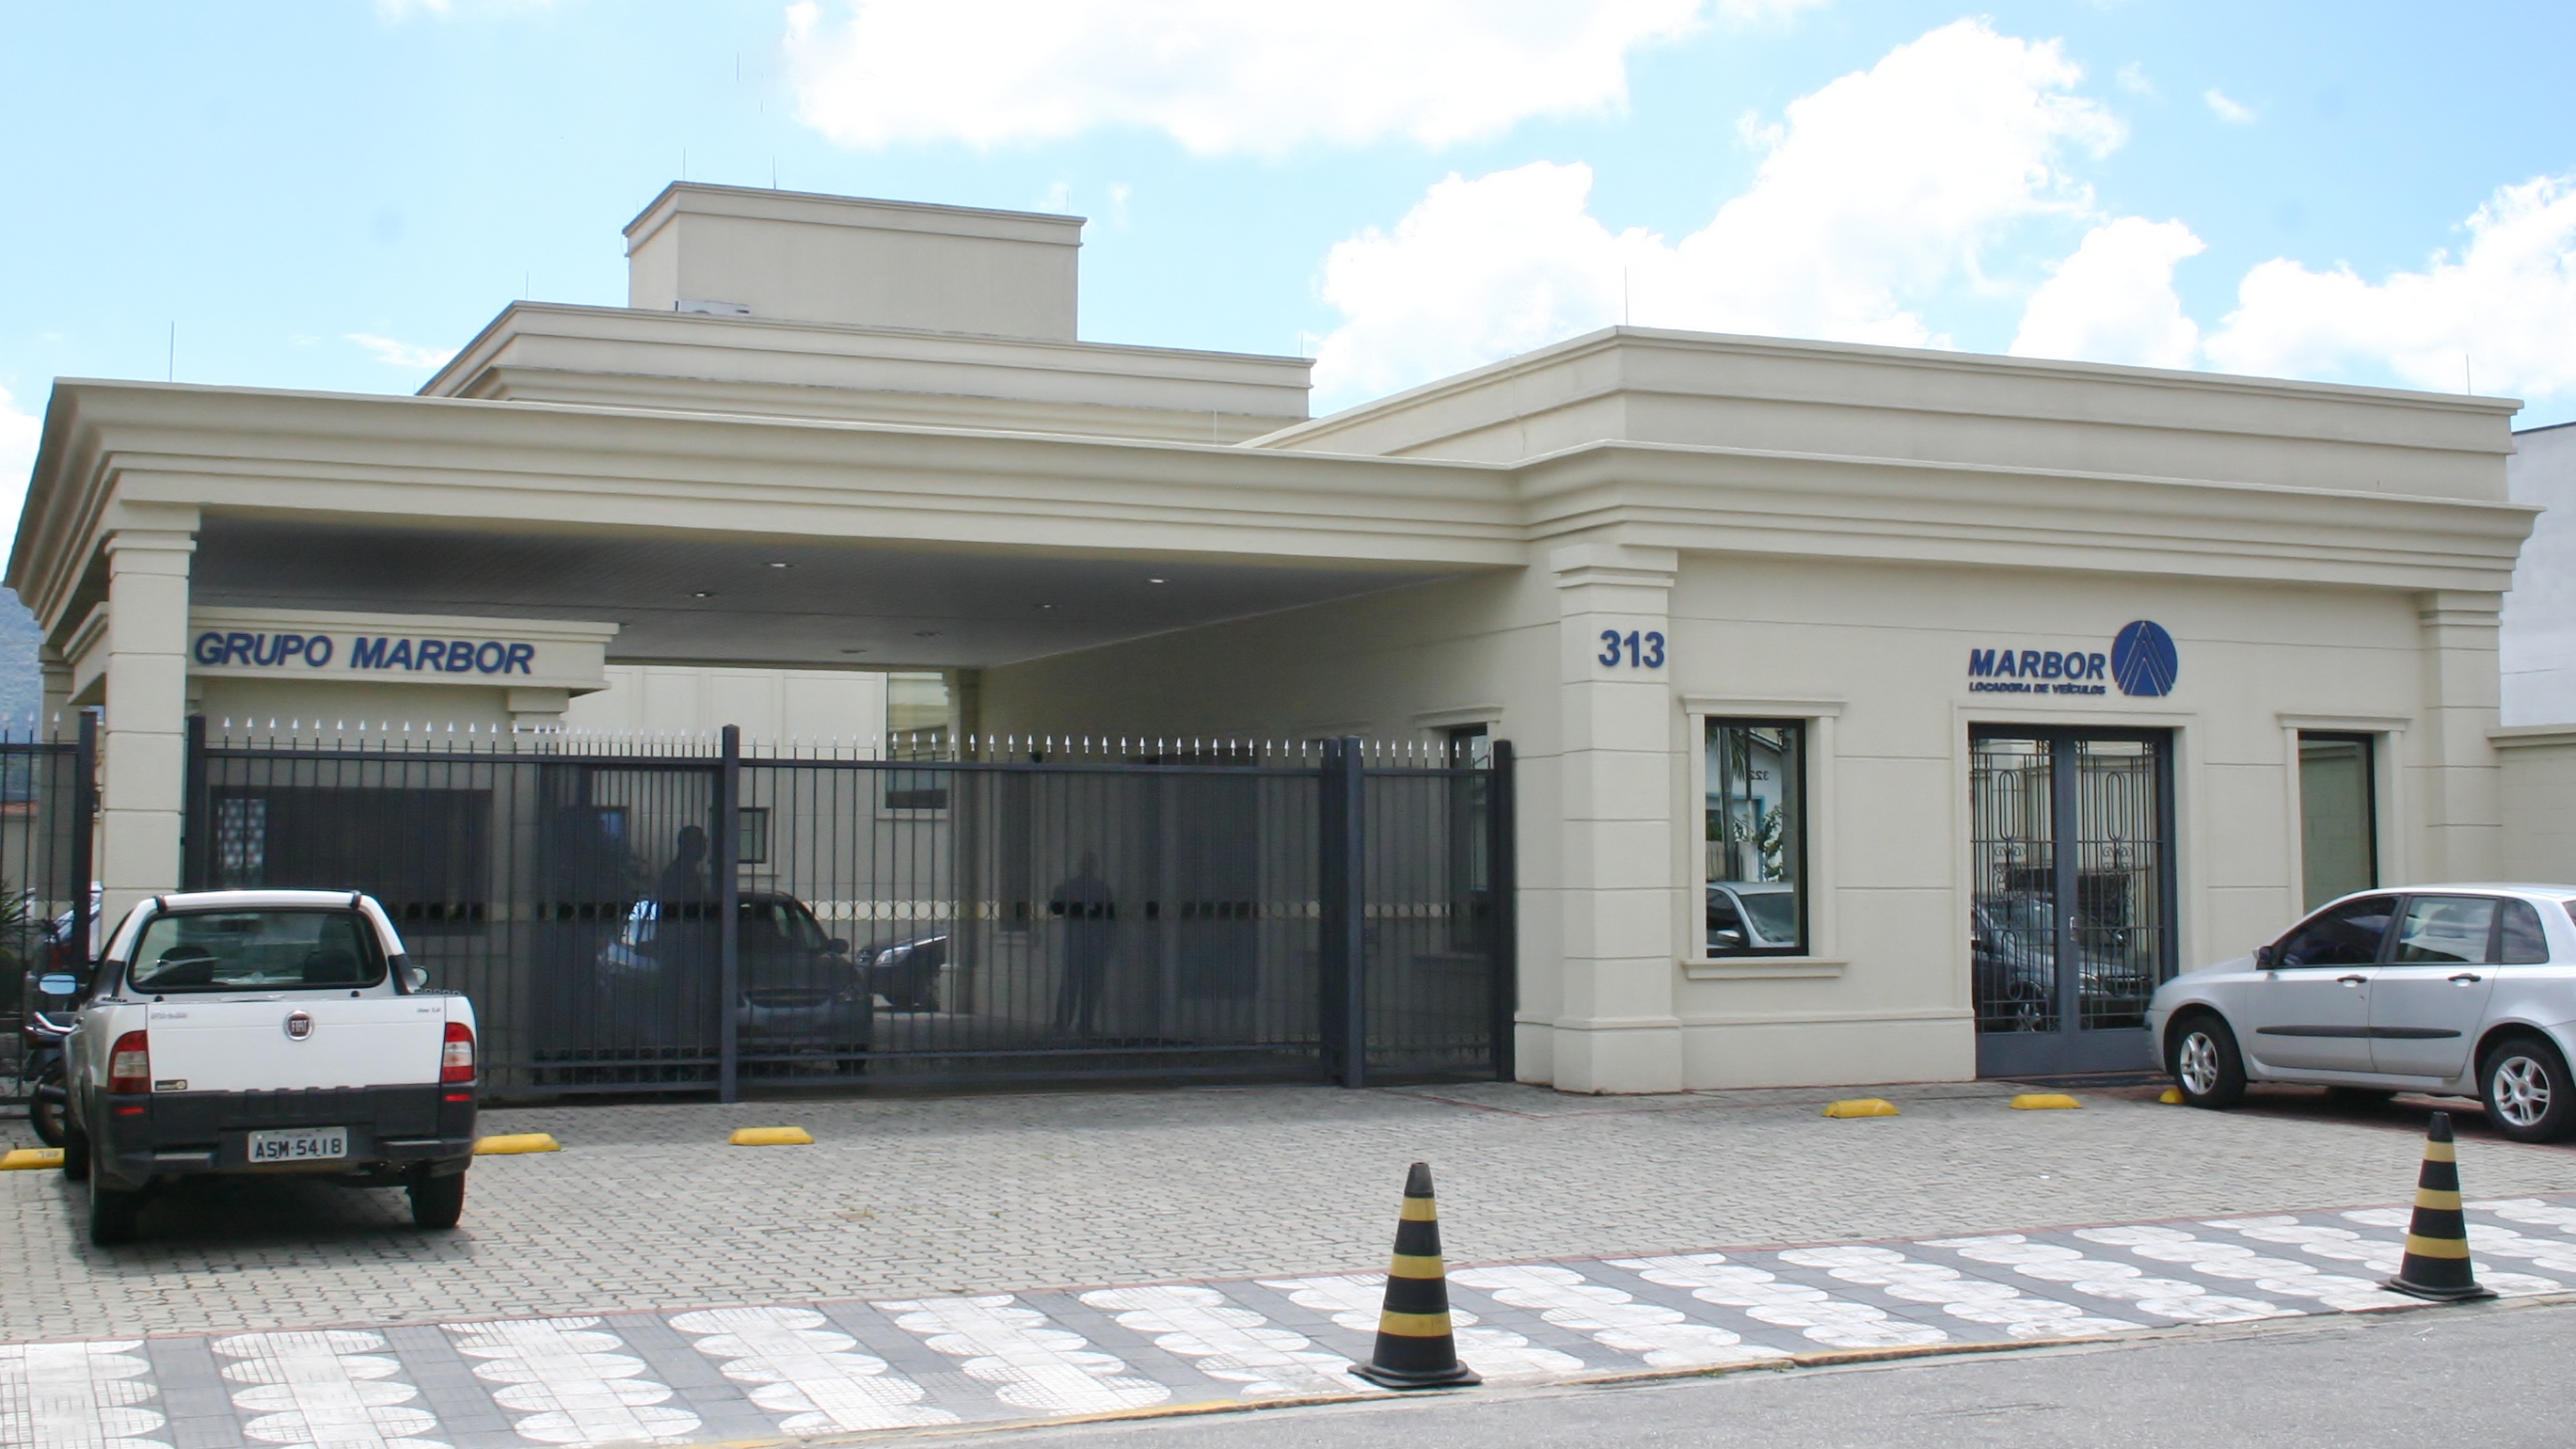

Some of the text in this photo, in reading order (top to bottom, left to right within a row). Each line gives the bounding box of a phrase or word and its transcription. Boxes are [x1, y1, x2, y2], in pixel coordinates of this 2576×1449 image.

[195, 632, 535, 674] GRUPO MARBOR
[1598, 629, 1664, 668] 313
[1968, 649, 2106, 679] MARBOR
[1969, 682, 2031, 693] LOCADORA
[2034, 684, 2049, 693] DE
